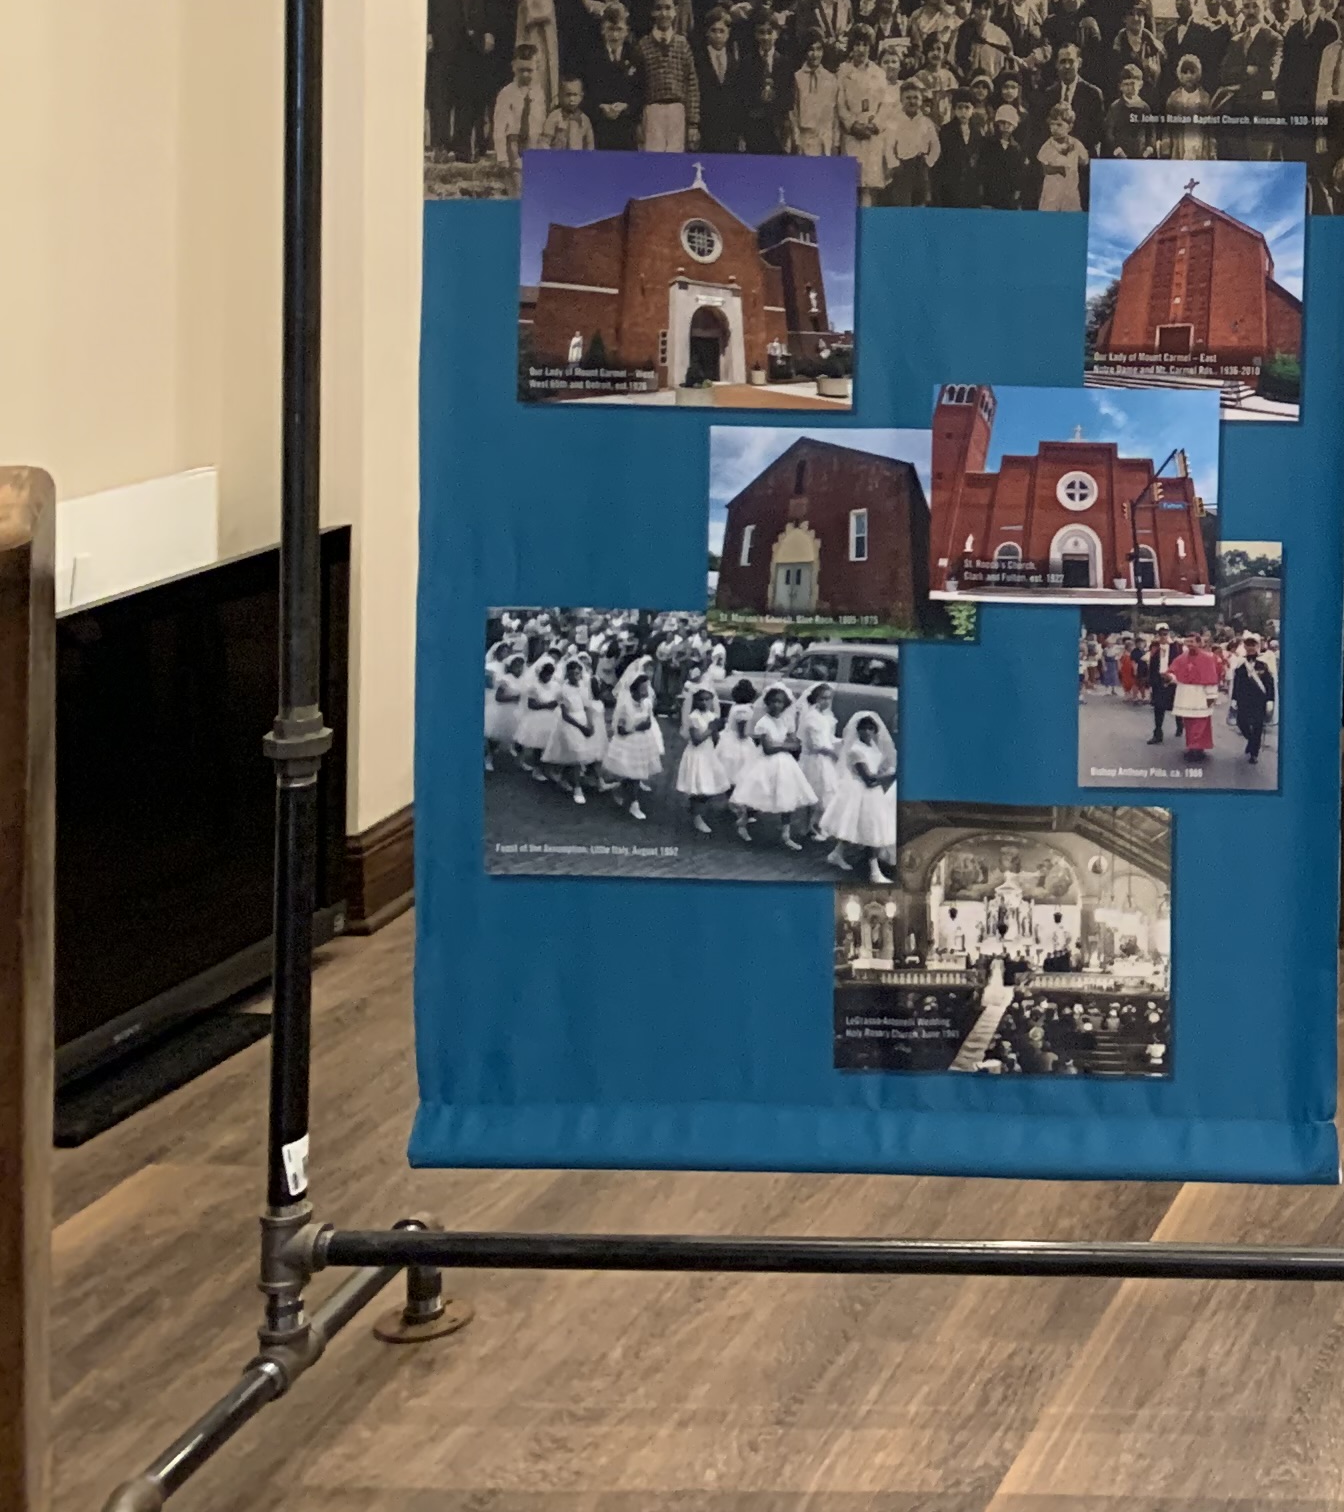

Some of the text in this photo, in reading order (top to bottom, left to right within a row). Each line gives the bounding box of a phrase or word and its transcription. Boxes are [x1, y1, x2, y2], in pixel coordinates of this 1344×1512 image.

[1130, 113, 1221, 127] St. Italian Baptist
[1095, 352, 1219, 365] Our Lady of Mount Carmel East
[1170, 366, 1197, 376] Carmel
[633, 845, 658, 857] August
